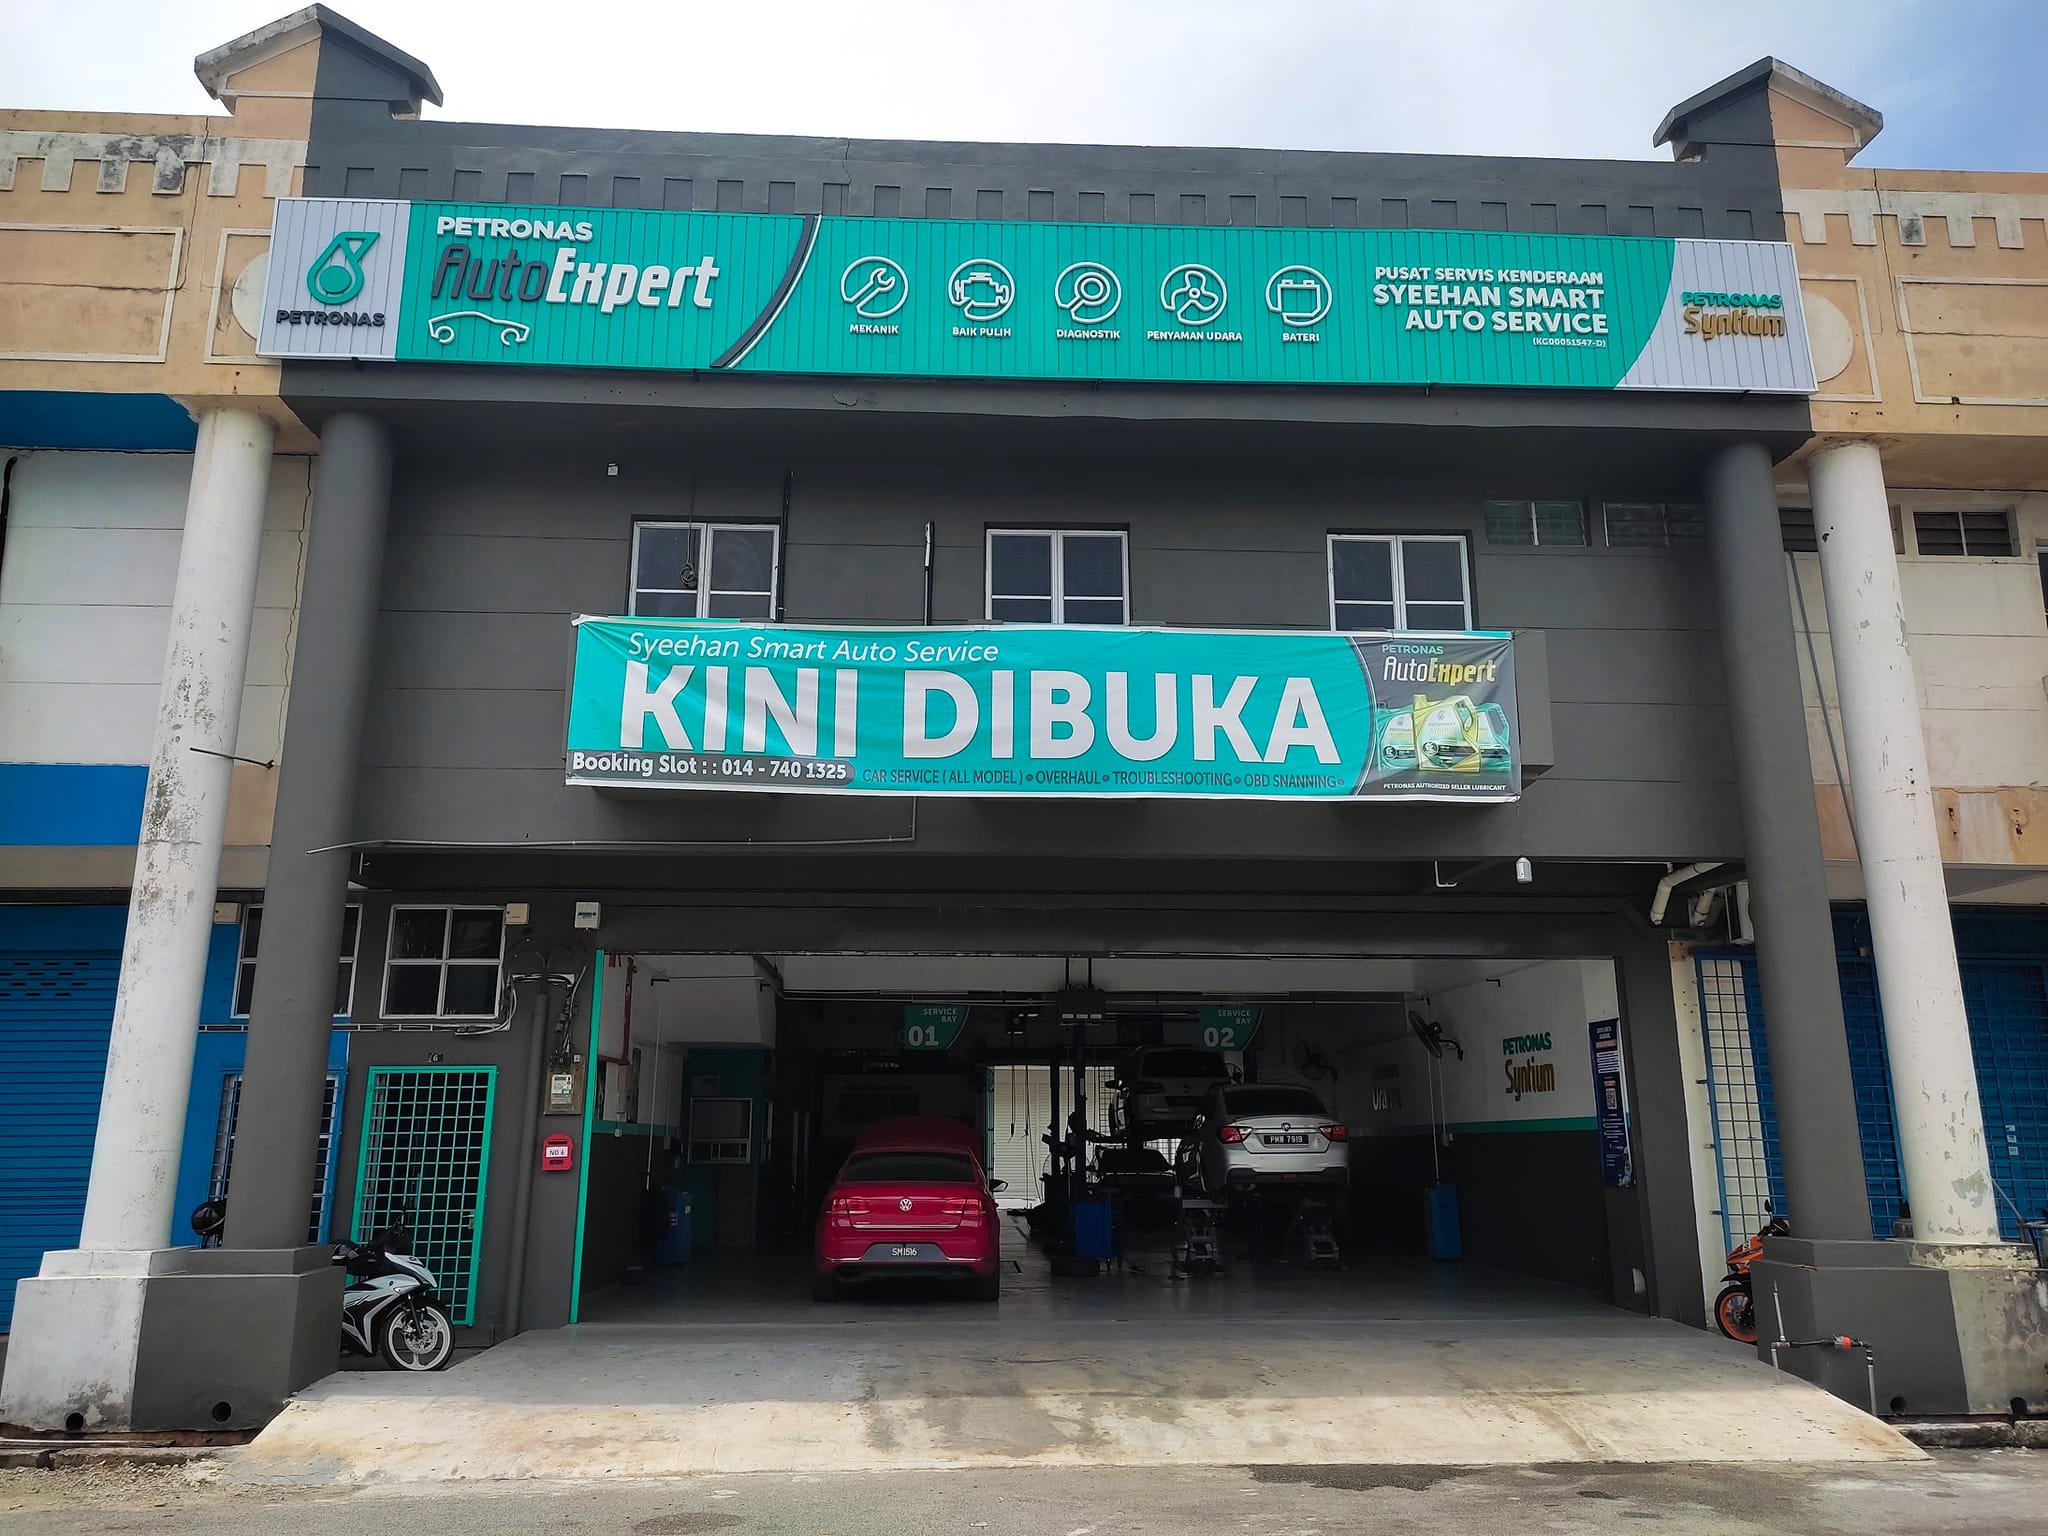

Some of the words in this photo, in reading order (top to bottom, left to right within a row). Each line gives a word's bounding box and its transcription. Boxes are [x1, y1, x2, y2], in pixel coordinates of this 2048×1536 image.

[437, 216, 593, 242] PETRONAS
[430, 242, 720, 314] AutoExpert
[1375, 266, 1431, 281] PUSAT
[1434, 267, 1494, 283] SERVIS
[1497, 269, 1604, 285] KENDERAAN
[1373, 284, 1501, 308] SYEEHAN
[1508, 286, 1605, 310] SMART
[1682, 291, 1783, 308] PETRONAS
[276, 309, 385, 327] PETRONAS
[1405, 309, 1485, 332] AUTO
[1491, 311, 1609, 335] SERVICE
[1683, 306, 1786, 341] Syntium
[849, 323, 899, 334] MEKANIK
[952, 326, 977, 337] BAIK
[980, 327, 1012, 338] PULIH
[1056, 328, 1121, 340] DIAGNOSTIK
[1147, 329, 1203, 341] PENYAMAN
[1206, 331, 1243, 342] UDARA
[1282, 332, 1320, 343] BATERI
[628, 632, 739, 661] Syeehan
[747, 636, 826, 661] Smart
[832, 639, 897, 662] Auto
[903, 640, 999, 663] Service
[1382, 644, 1444, 655] PETRONAS
[1383, 655, 1497, 687] AutoExpert
[620, 659, 858, 758] KINI
[902, 668, 1342, 764] DIBUKA
[572, 751, 653, 778] Booking
[658, 754, 697, 774] Slot
[722, 758, 754, 776] 014
[769, 760, 801, 778] 740
[806, 762, 847, 780] 1325
[862, 769, 887, 783] CAR
[890, 769, 939, 784] SERVICE
[1035, 770, 1101, 785] OVERHAUL
[1112, 771, 1232, 787] TROUBLESHOOTING
[1244, 773, 1270, 787] OBD
[1415, 782, 1450, 790] AUTHORIZED
[923, 1008, 957, 1017] SERVICE
[941, 1015, 958, 1023] BAY
[1217, 1009, 1251, 1018] SERVICE
[1235, 1017, 1251, 1025] BAY
[908, 1025, 939, 1047] 01
[1203, 1026, 1235, 1048] 02
[1502, 1031, 1552, 1055] PETRONAS
[1504, 1056, 1555, 1102] Syntium
